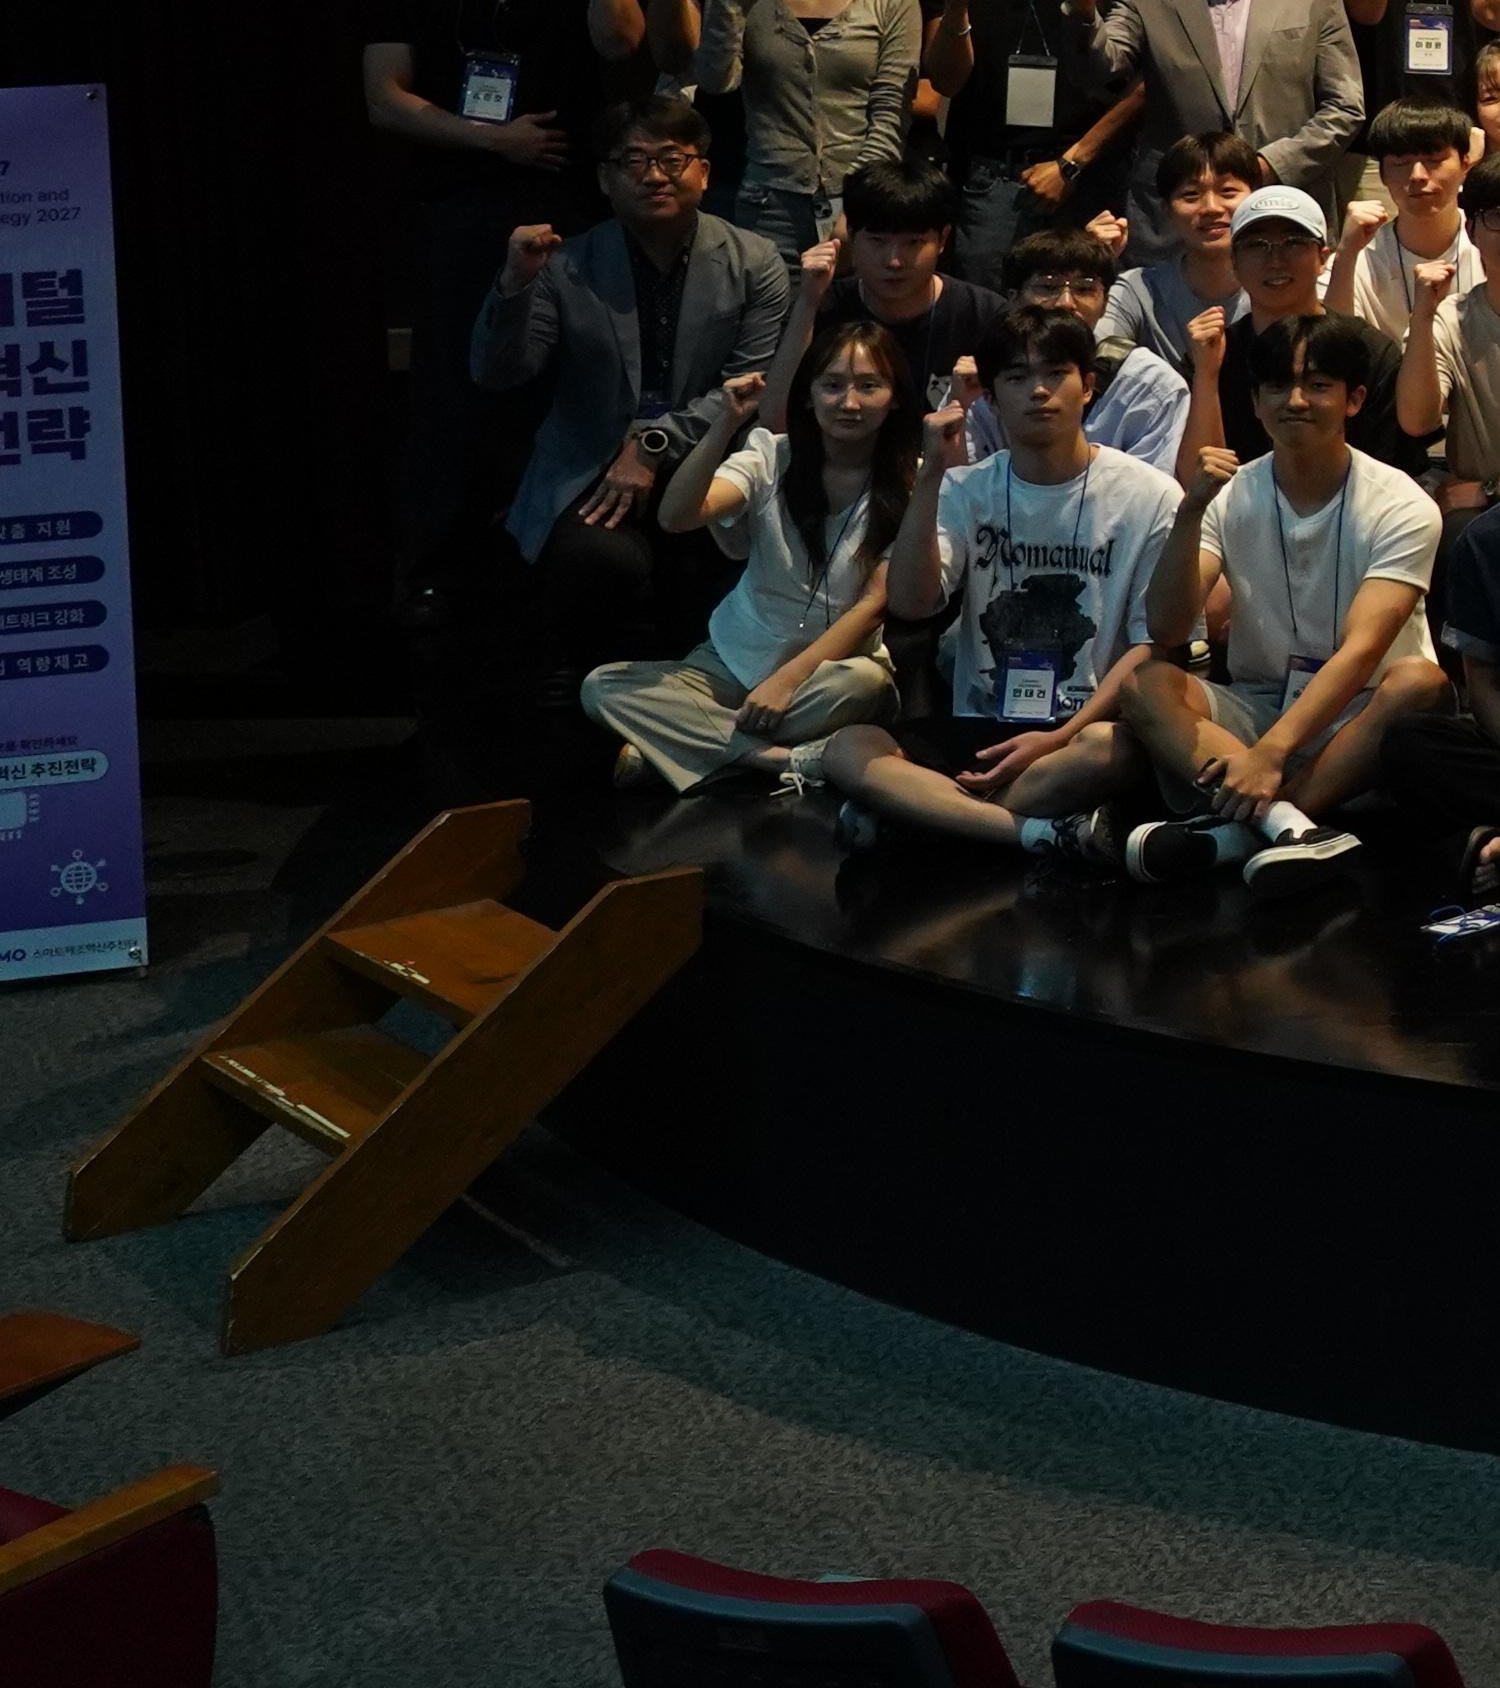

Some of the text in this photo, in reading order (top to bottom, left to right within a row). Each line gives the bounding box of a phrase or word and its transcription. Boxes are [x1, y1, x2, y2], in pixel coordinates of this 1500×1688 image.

[38, 188, 69, 202] and
[37, 207, 81, 223] 2027
[38, 519, 71, 538] 지원
[975, 524, 1115, 578] Nomanual
[47, 563, 78, 583] 조성
[54, 607, 86, 627] 강화
[31, 757, 97, 778] 추진전략
